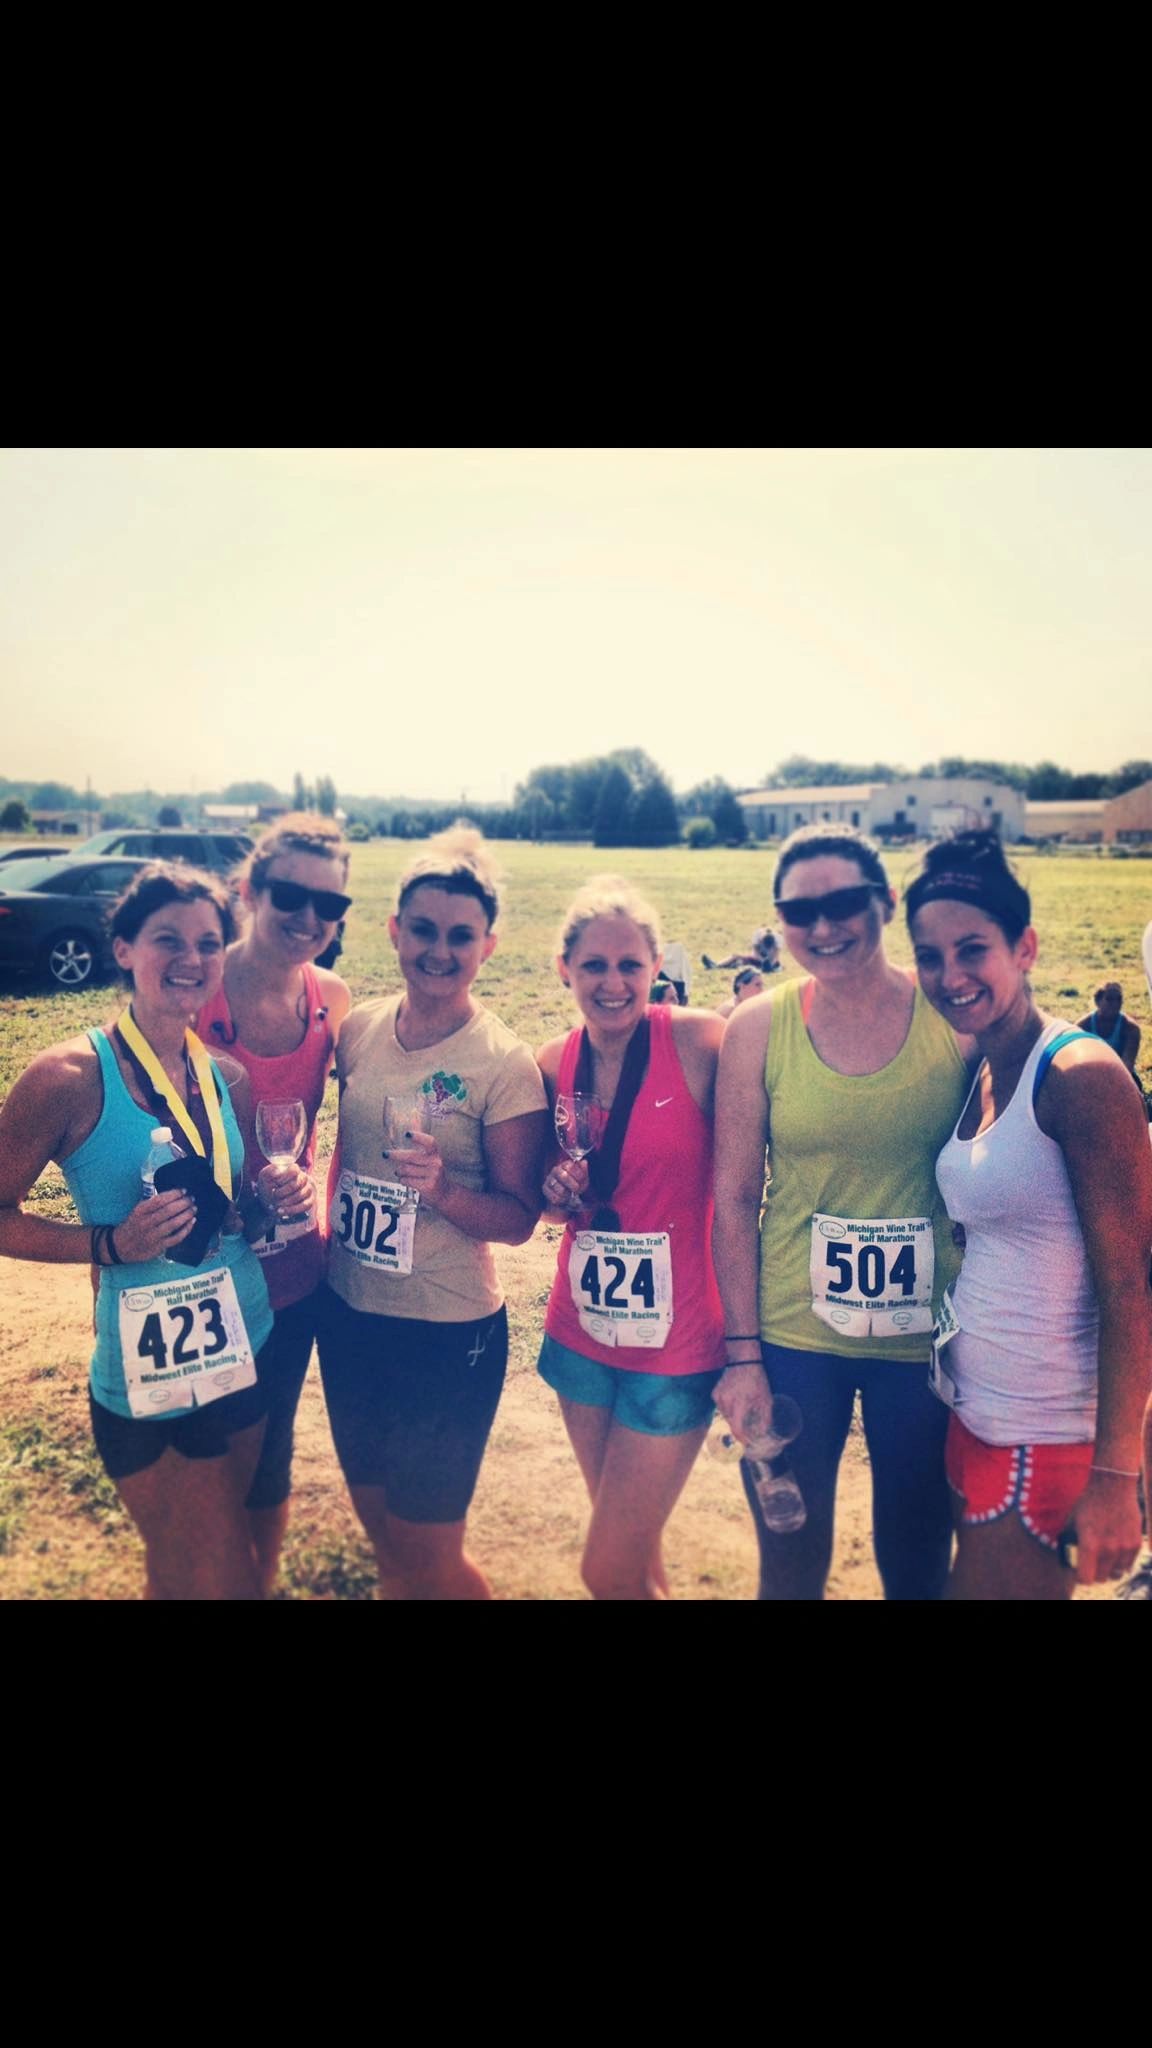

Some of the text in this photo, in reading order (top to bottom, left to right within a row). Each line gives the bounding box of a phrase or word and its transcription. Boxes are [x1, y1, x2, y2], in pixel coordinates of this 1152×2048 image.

[336, 1193, 400, 1256] 302
[847, 1224, 885, 1235] Michigan
[887, 1224, 905, 1232] Wine
[907, 1223, 925, 1232] Trail
[596, 1235, 625, 1248] Michigan
[626, 1238, 644, 1246] Wine
[646, 1237, 662, 1246] Trail
[859, 1234, 915, 1243] Half Marathon
[604, 1246, 653, 1255] Half Marathon
[373, 1255, 399, 1269] Racing
[826, 1241, 917, 1298] 504
[153, 1273, 225, 1298] Michigan Wine Trail
[580, 1255, 655, 1308] 424
[166, 1294, 183, 1306] Half
[185, 1287, 218, 1302] Marathon
[825, 1294, 918, 1309] Midwest Elite Racing
[611, 1311, 629, 1319] Elite
[631, 1312, 660, 1320] Racing
[137, 1297, 228, 1369] 423
[140, 1353, 237, 1384] Midwest Elite Racing
